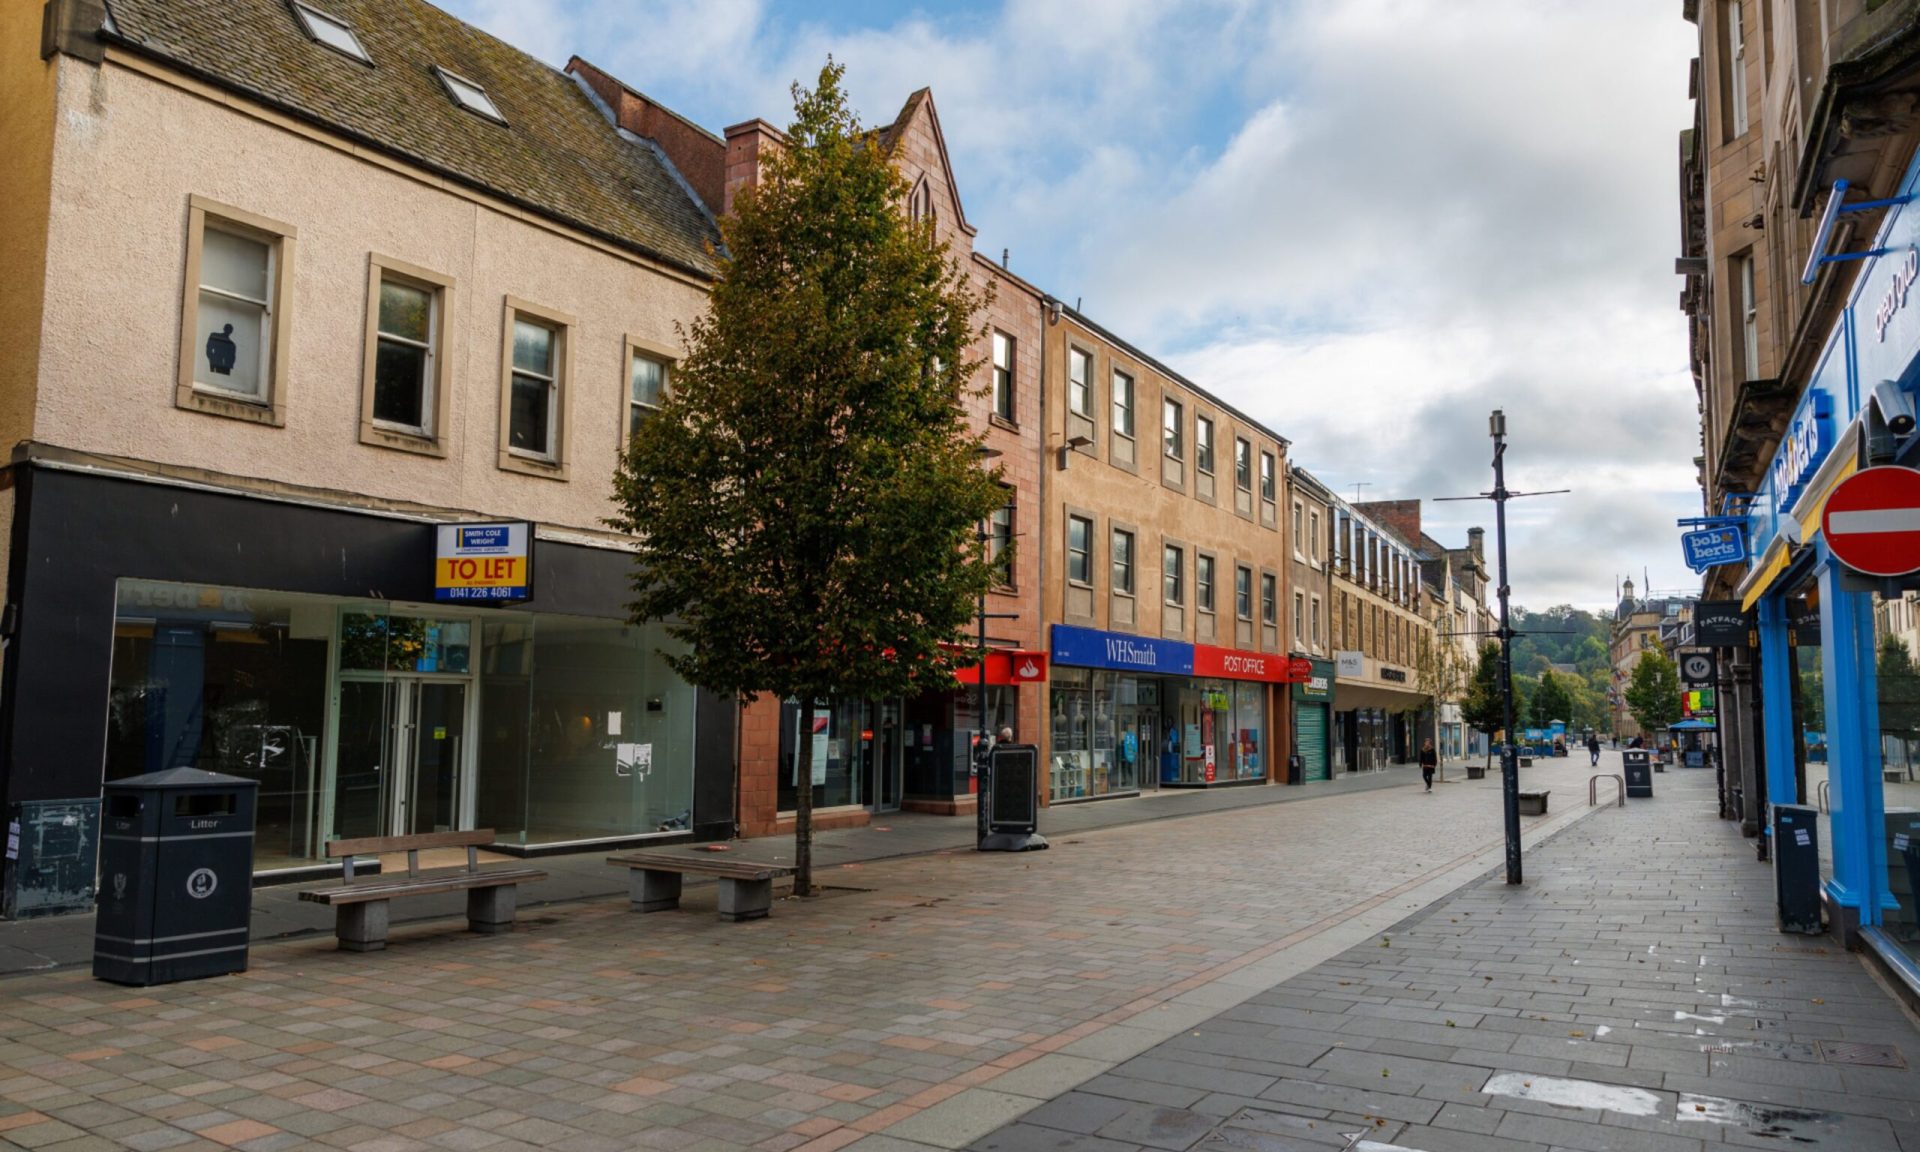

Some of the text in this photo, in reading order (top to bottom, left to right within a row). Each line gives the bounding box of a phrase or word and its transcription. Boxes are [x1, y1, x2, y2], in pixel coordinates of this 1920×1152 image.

[485, 529, 502, 537] COLE
[1693, 543, 1735, 559] berts
[448, 558, 516, 579] TO LET
[450, 587, 512, 598] 0141 226 4061
[1106, 638, 1156, 666] WHSmith
[1224, 656, 1264, 674] POST OFFICE
[1341, 658, 1358, 666] M&S
[191, 819, 218, 829] Litter
